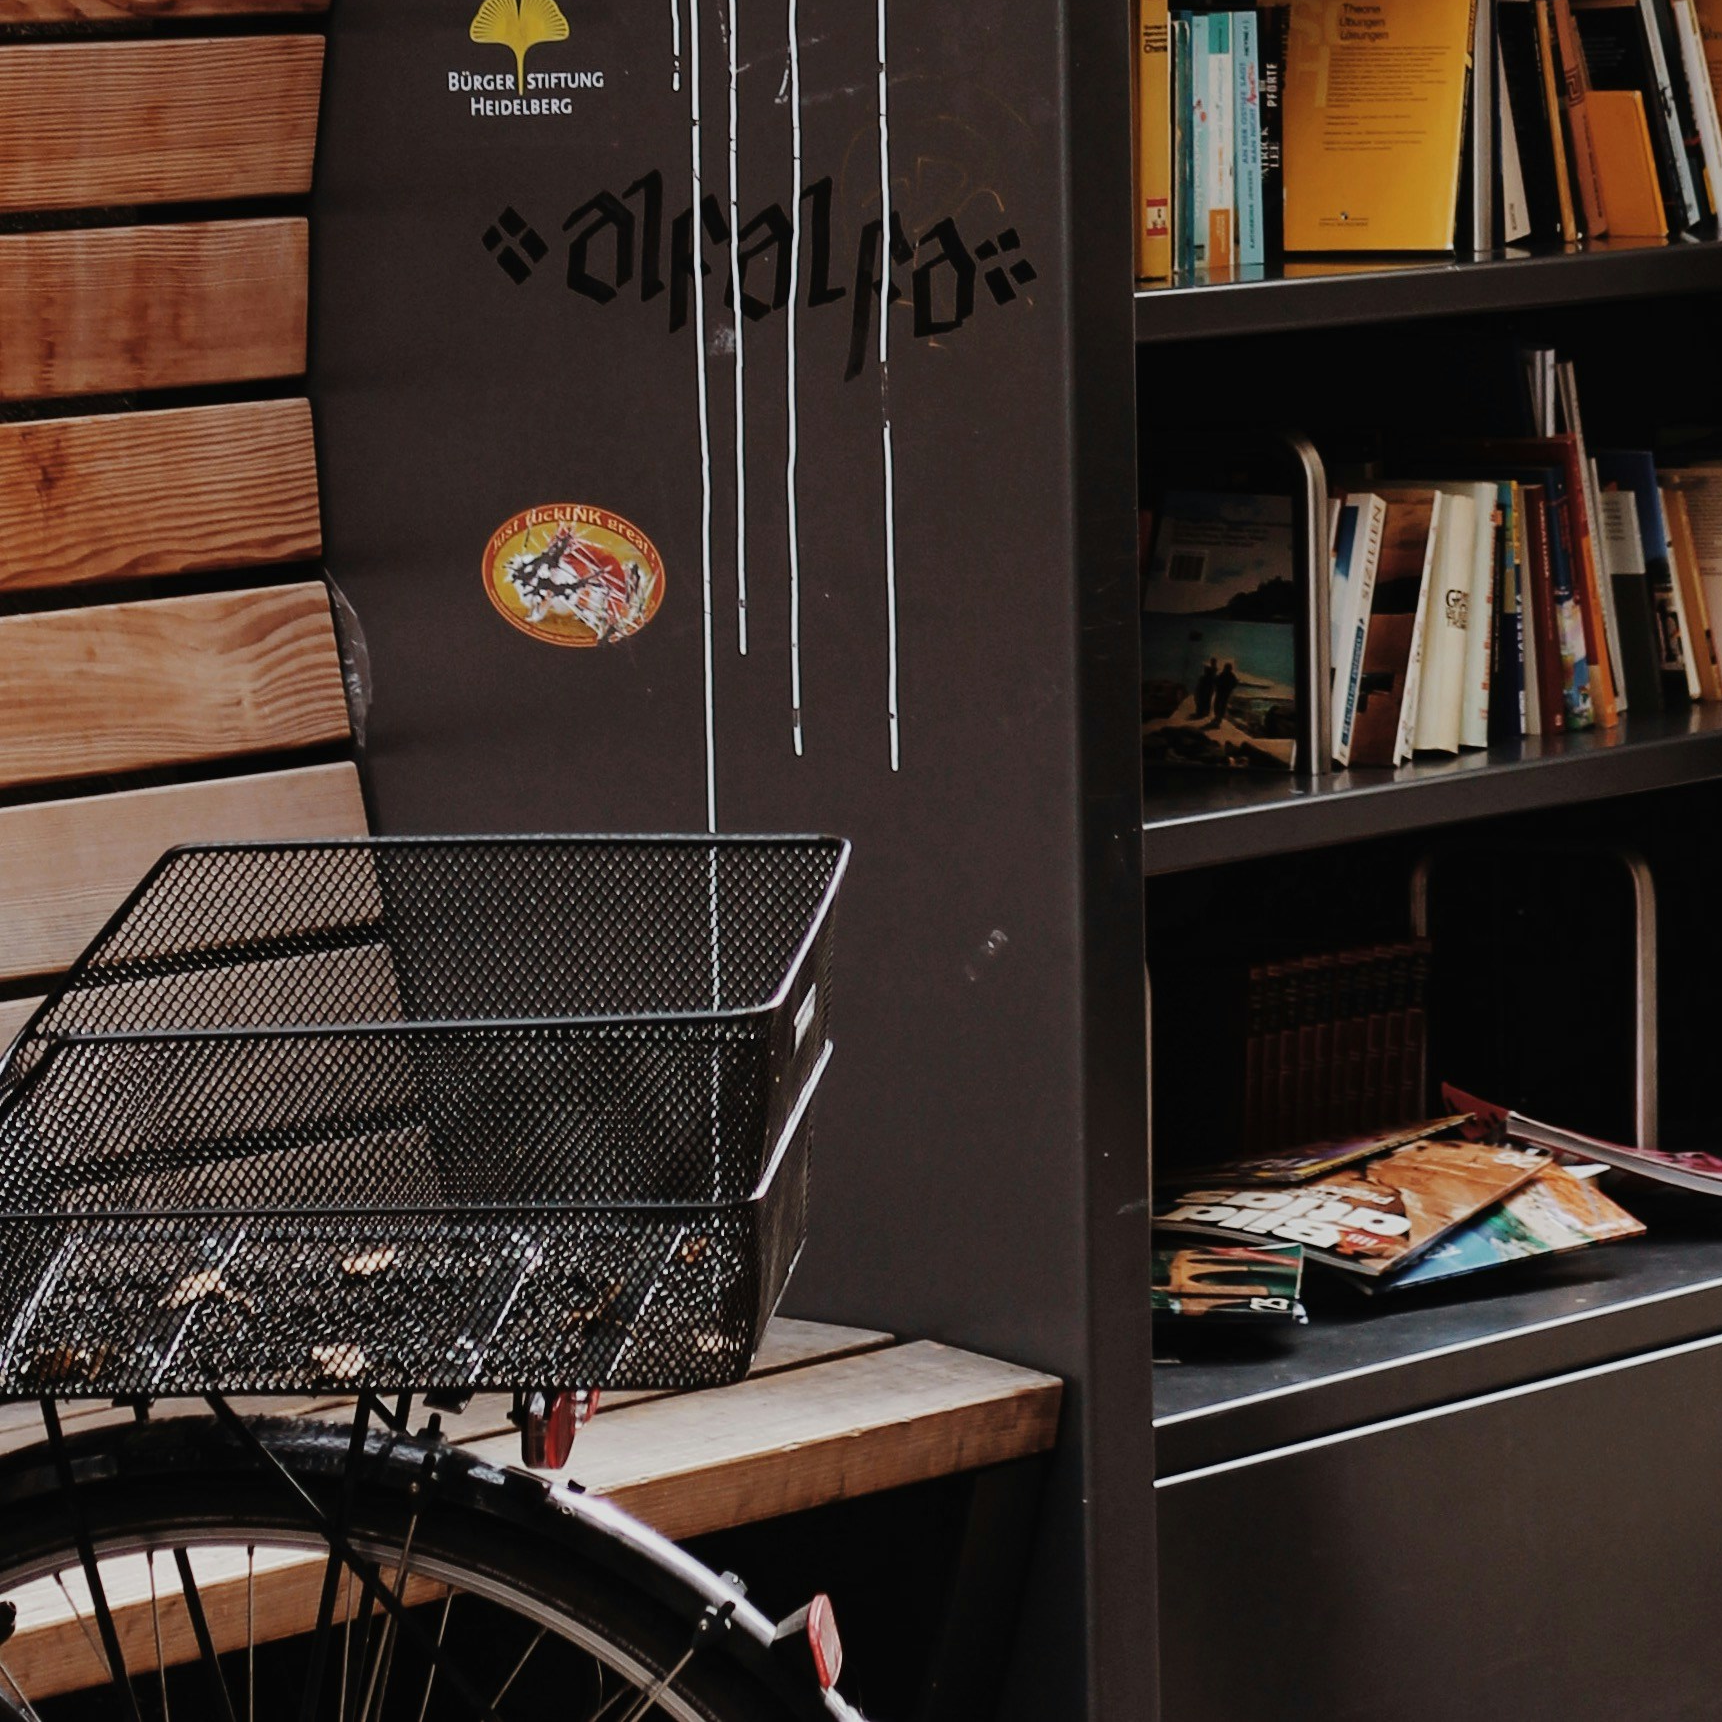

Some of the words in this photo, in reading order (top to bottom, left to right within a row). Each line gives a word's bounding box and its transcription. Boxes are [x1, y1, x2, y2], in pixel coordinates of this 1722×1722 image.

[1339, 16, 1386, 29] Übungen
[447, 69, 515, 91] BÜRGER
[526, 69, 604, 91] STIFTUNG
[1266, 63, 1278, 107] PFORTE
[470, 97, 573, 117] HEIDELBERG
[1361, 504, 1382, 601] SIZILIEN
